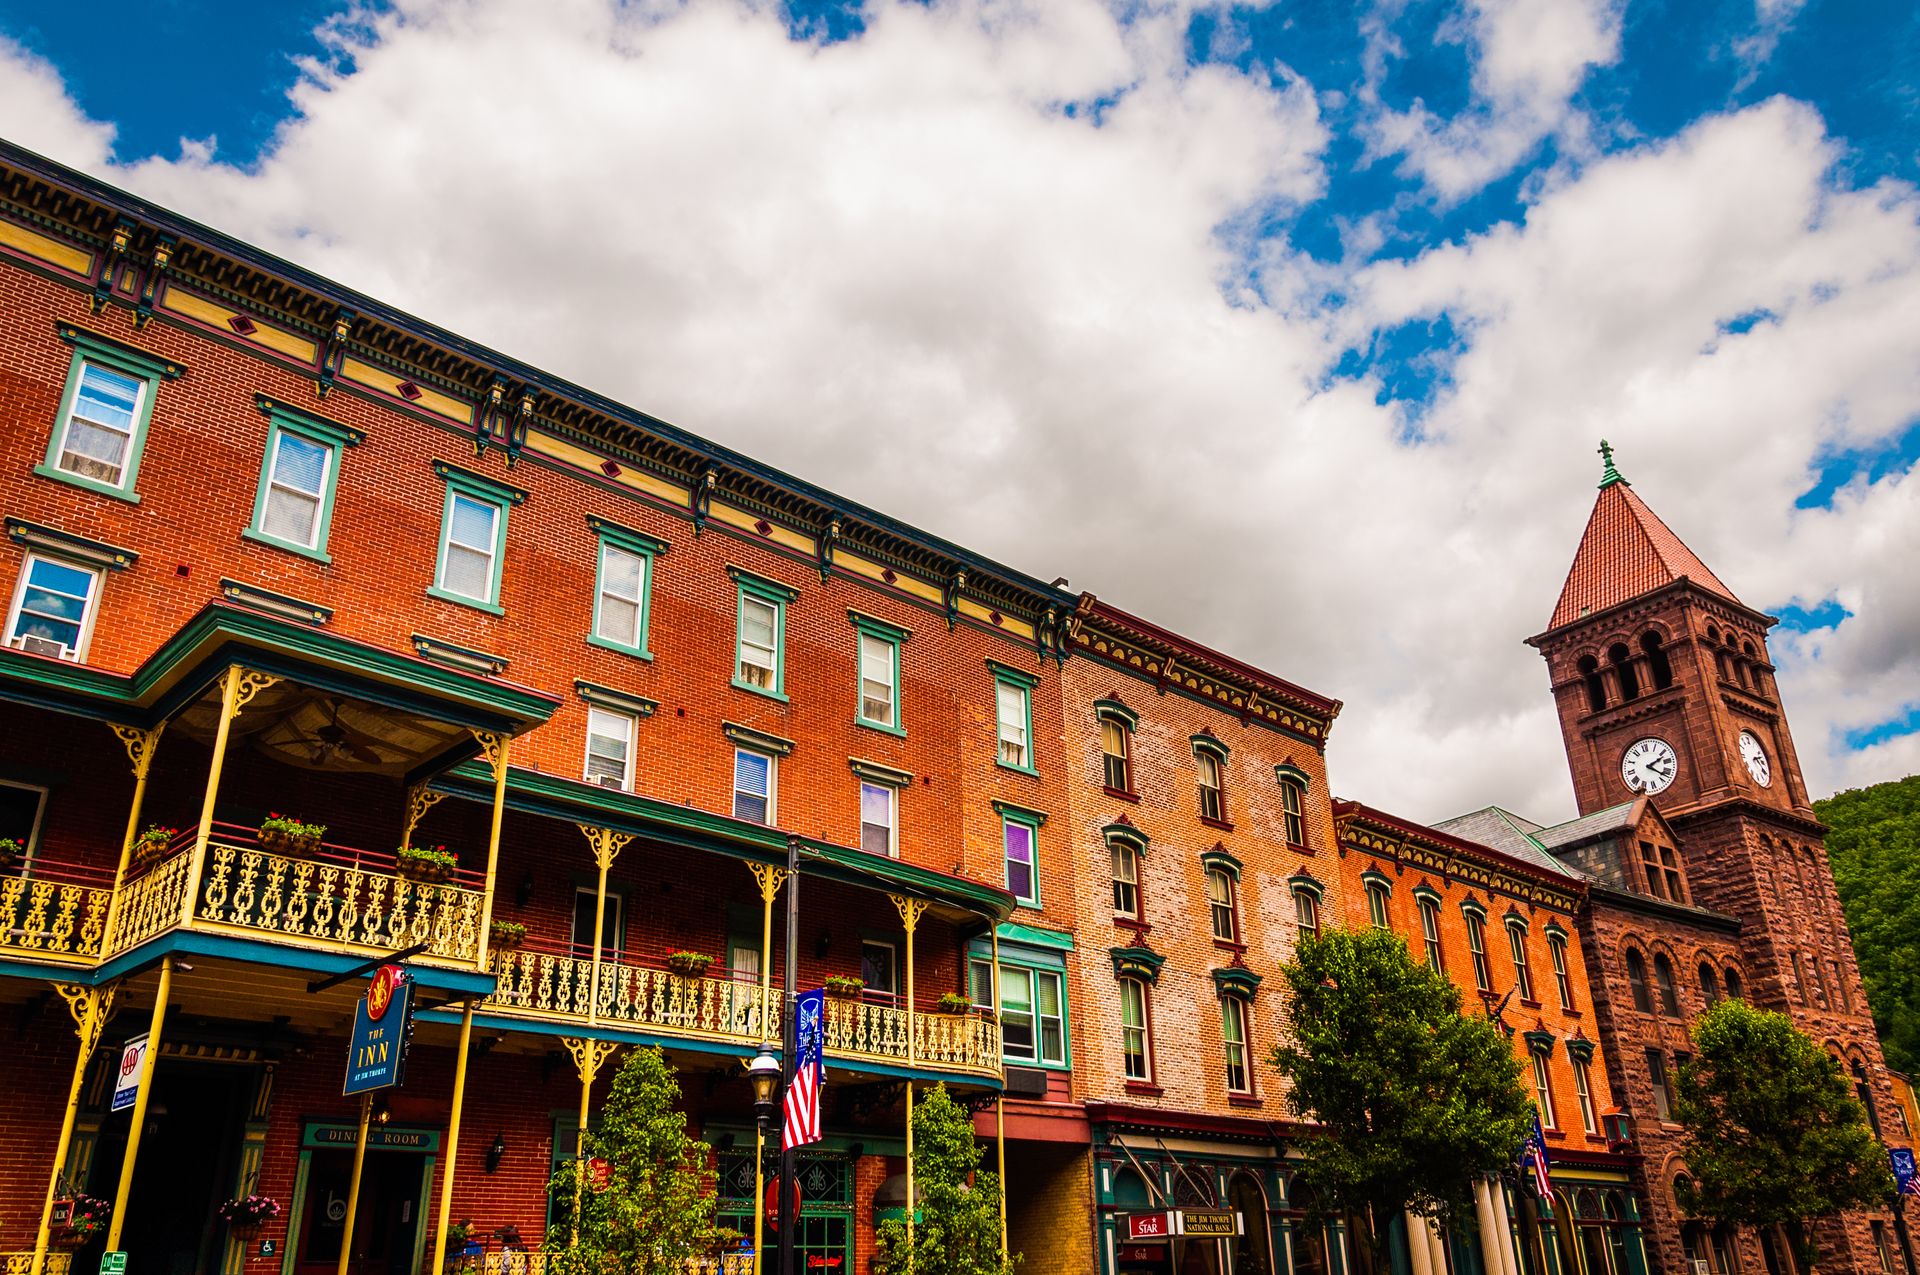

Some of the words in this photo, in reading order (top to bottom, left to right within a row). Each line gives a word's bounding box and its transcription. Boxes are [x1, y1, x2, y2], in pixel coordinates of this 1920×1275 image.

[369, 1028, 384, 1040] THE
[357, 1041, 388, 1068] INN
[369, 1067, 387, 1077] THORPE
[329, 1130, 374, 1142] DINIG
[385, 1133, 419, 1144] ROOM
[1186, 1215, 1197, 1223] THE
[1199, 1215, 1208, 1223] JIM
[1209, 1215, 1229, 1223] THORPE
[1138, 1223, 1158, 1234] STAR
[1187, 1223, 1214, 1231] NATIONAL
